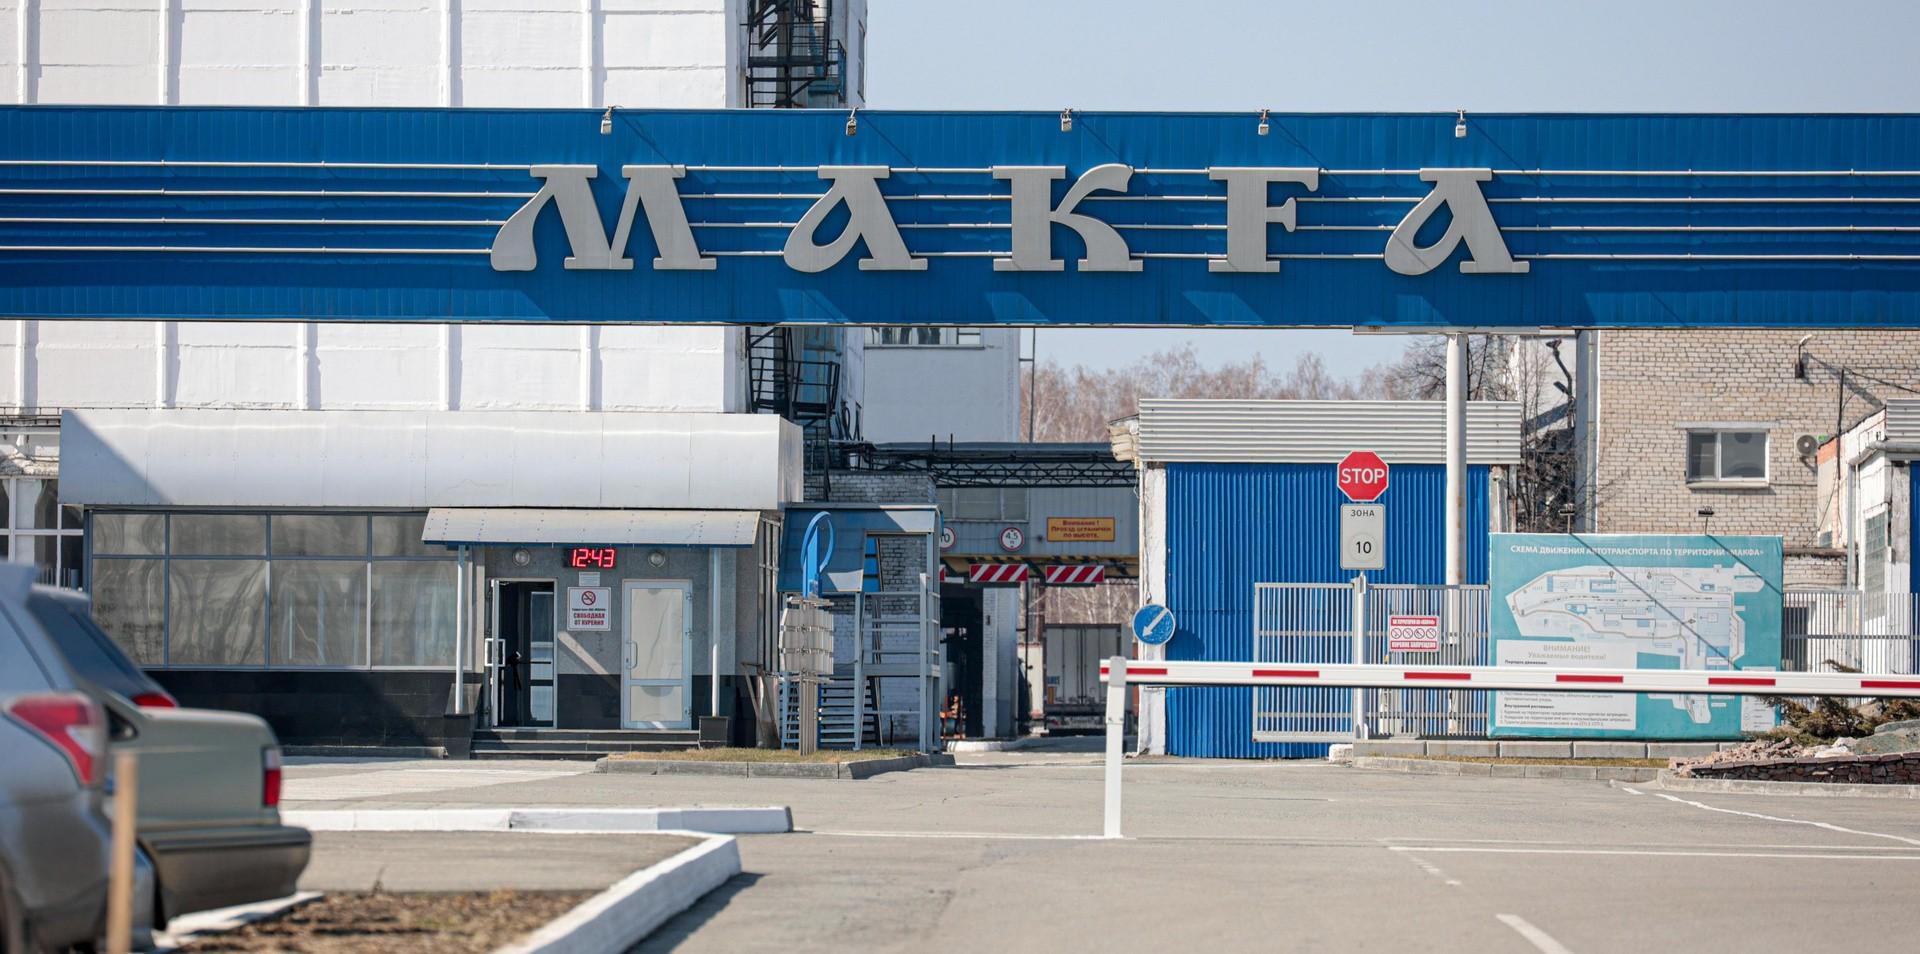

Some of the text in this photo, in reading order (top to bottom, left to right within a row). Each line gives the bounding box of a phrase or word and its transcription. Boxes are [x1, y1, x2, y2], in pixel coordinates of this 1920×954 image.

[490, 163, 1530, 275] MAKFA
[1340, 468, 1385, 484] STOP
[1350, 509, 1375, 517] ЗОНА
[1356, 541, 1372, 554] 10
[1510, 545, 1537, 553] СХЕМА
[1539, 546, 1585, 554] ДВИЖЕНИЯ
[1660, 548, 1672, 556] ПО
[1674, 548, 1725, 557] ТЕРРИТОРИИ
[572, 549, 615, 567] 12:43
[1543, 644, 1590, 652] ВНИМАНИЕ!
